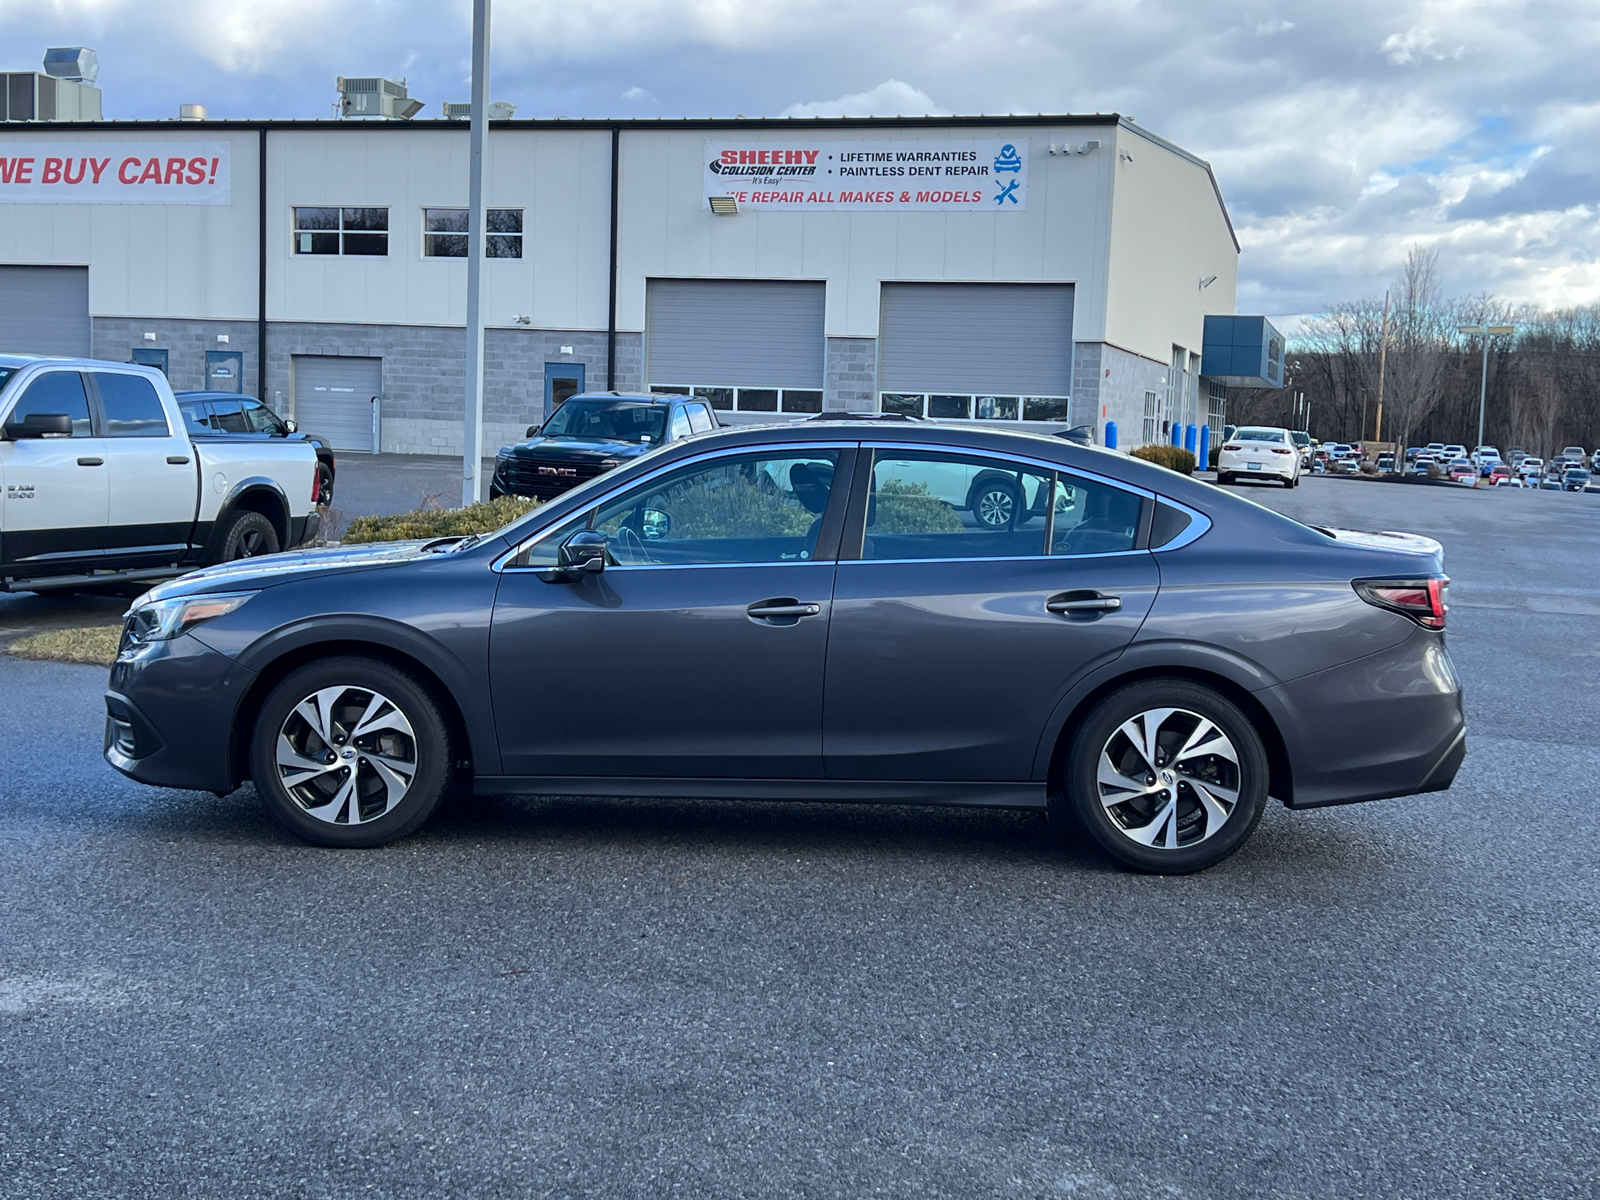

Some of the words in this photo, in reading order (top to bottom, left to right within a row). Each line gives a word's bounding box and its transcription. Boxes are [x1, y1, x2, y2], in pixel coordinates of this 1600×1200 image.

[720, 150, 820, 164] SHEEHY
[840, 152, 893, 162] LIFETIME
[896, 151, 977, 162] WARRANTIES
[41, 157, 112, 185] BUY
[117, 156, 220, 185] CARS!
[720, 165, 774, 176] COLLISION
[776, 165, 817, 176] CENTER
[840, 167, 905, 176] PAINTLESS
[908, 166, 942, 176] DENT
[945, 165, 989, 176] REPAIR
[752, 177, 762, 185] It's
[763, 177, 782, 186] Easy!
[751, 191, 804, 203] REPAIR
[806, 191, 835, 203] ALL
[839, 191, 894, 203] MAKES
[898, 191, 911, 203] &
[915, 190, 982, 203] MODELS
[537, 466, 577, 477] GMC
